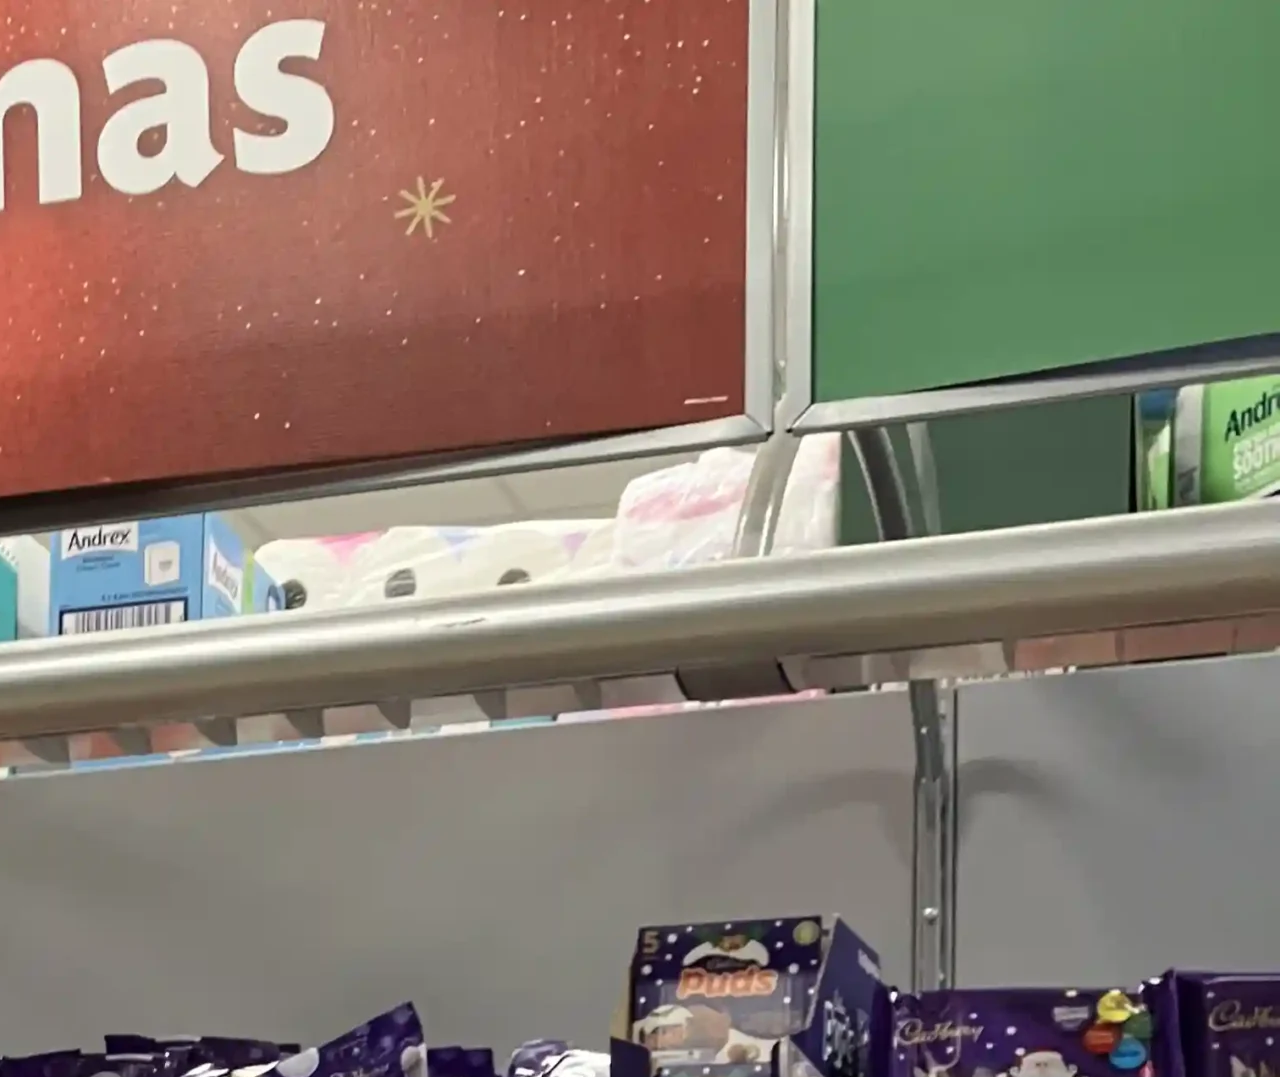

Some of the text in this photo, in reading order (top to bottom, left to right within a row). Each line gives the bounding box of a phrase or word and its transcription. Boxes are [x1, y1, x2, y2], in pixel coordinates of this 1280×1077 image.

[1224, 391, 1280, 442] Andr
[67, 526, 131, 553] Andrex
[676, 965, 779, 1000] Puds
[895, 1018, 984, 1049] Cadbury
